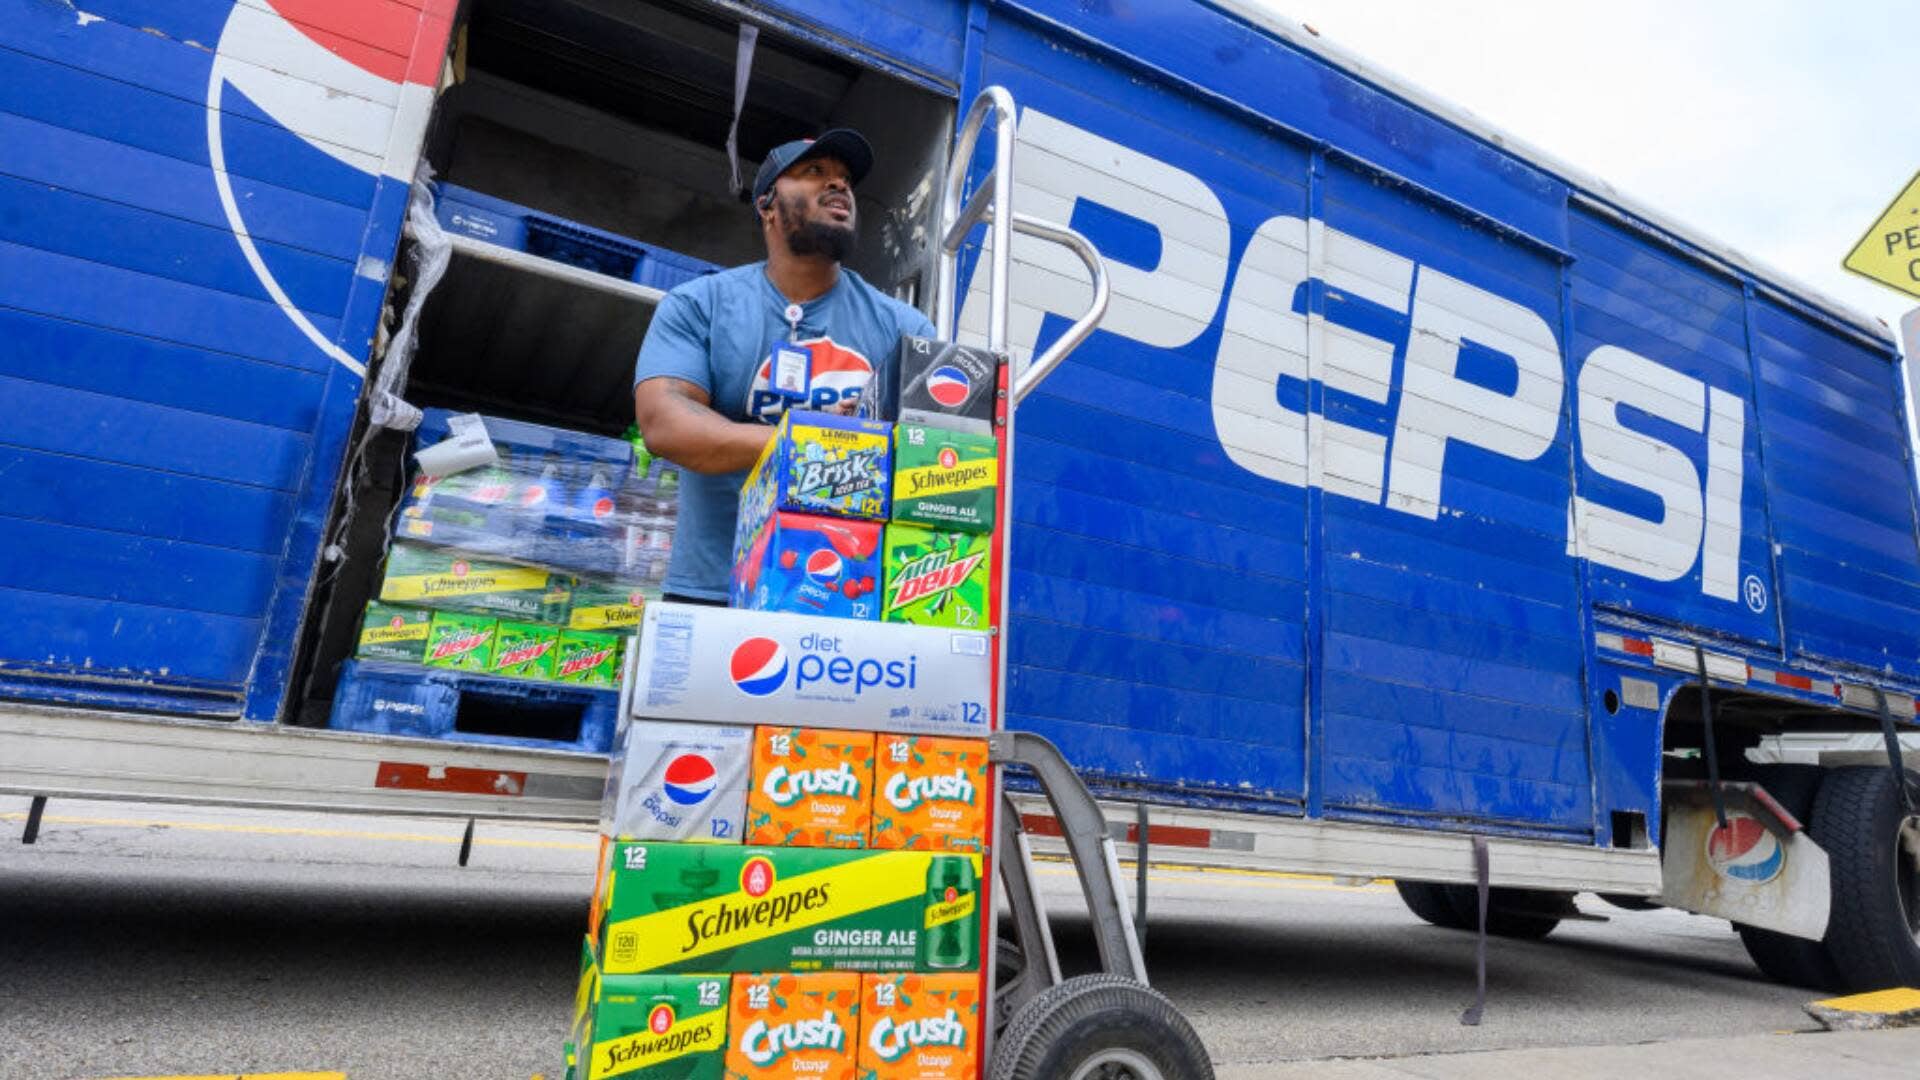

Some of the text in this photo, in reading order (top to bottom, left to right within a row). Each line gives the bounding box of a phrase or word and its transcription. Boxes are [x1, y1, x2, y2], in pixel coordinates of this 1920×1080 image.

[957, 106, 1744, 603] PEPSI
[820, 429, 859, 441] LEMON
[907, 427, 926, 441] 12
[909, 466, 988, 494] Schweppes
[917, 501, 958, 515] GINGER
[958, 507, 978, 517] ALE
[800, 632, 842, 653] diet
[795, 655, 917, 695] pepsi
[962, 702, 982, 724] 12
[769, 735, 791, 749] 12
[888, 741, 909, 756] 12
[763, 762, 860, 806] Crush
[884, 768, 975, 812] Crush
[811, 801, 846, 817] Orange
[929, 807, 963, 822] Orange
[711, 818, 729, 838] 12
[623, 846, 648, 864] 12
[682, 882, 831, 953] Schweppes
[814, 930, 917, 946] GINGER ALE
[697, 981, 721, 999] 12
[747, 984, 770, 1001] 12
[875, 983, 896, 999] 12
[741, 1009, 845, 1067] Crush
[869, 1008, 967, 1062] Crush
[603, 1022, 714, 1073] Schweppes
[792, 1058, 830, 1073] Orange
[917, 1053, 953, 1068] Orange
